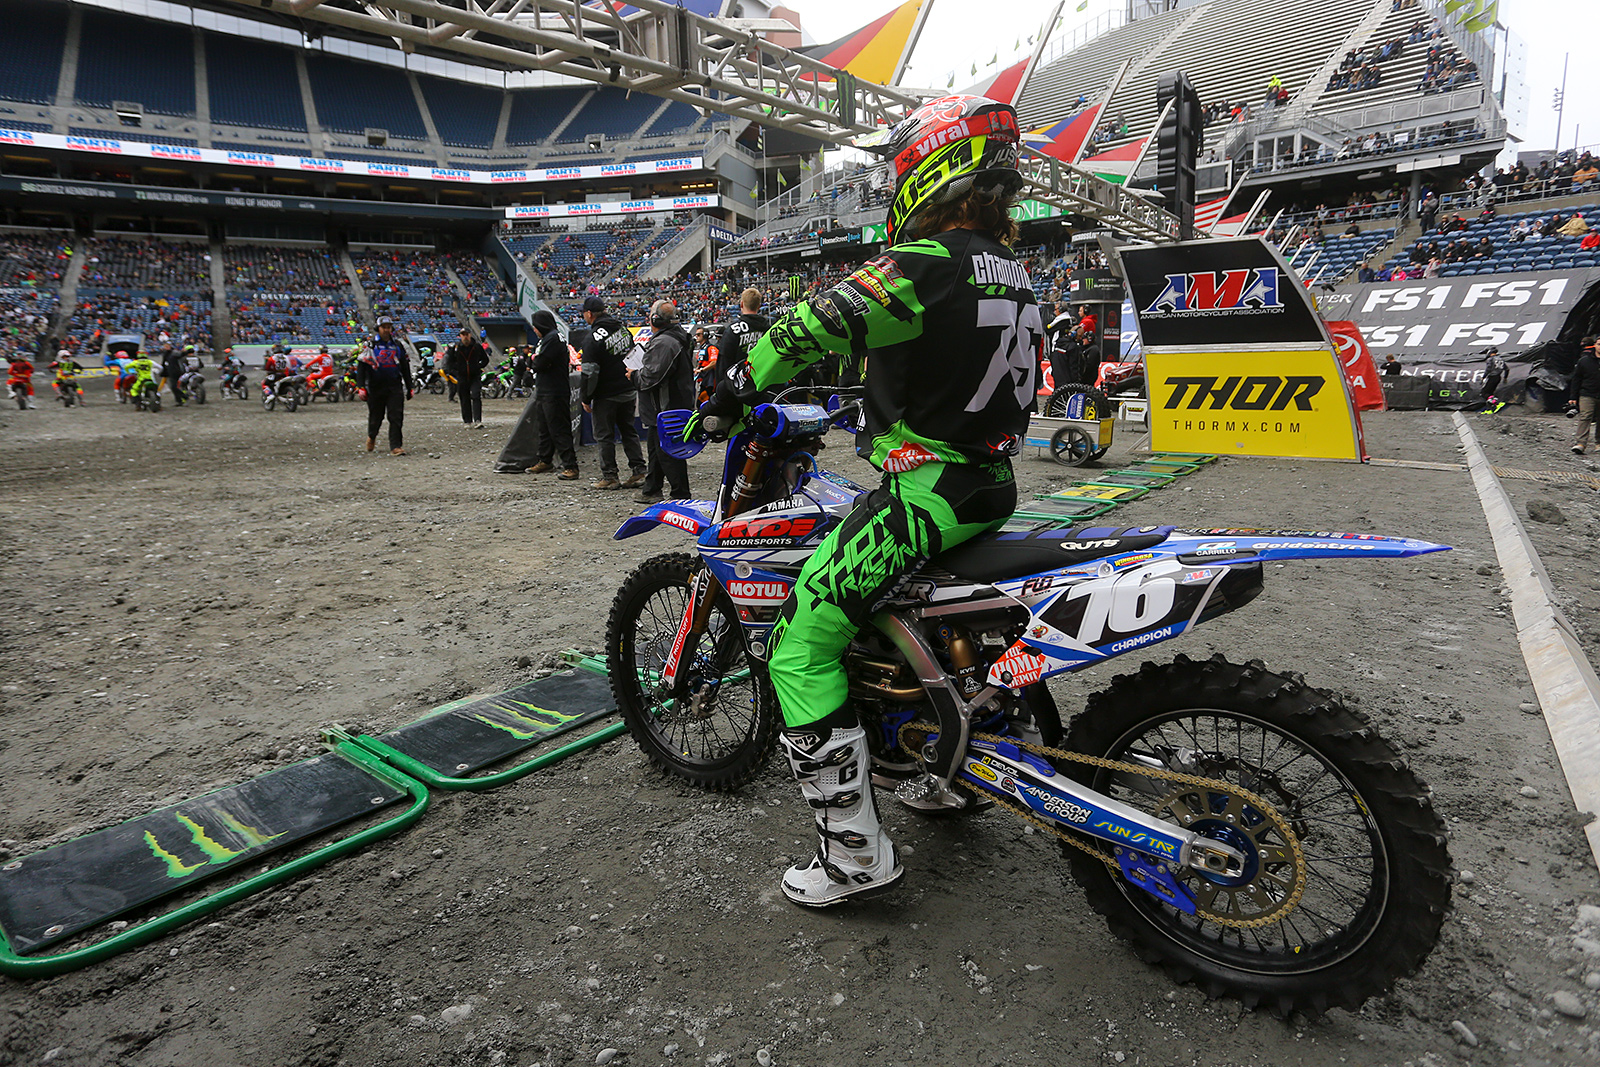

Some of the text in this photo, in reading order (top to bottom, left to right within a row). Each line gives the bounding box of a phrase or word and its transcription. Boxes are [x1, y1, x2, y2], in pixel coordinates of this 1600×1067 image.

[0, 129, 34, 140] RTS
[916, 120, 971, 157] viral
[66, 136, 121, 149] PARTS
[66, 144, 122, 154] UNLIMITED
[151, 144, 202, 156] PARTS
[151, 151, 202, 161] UNLIMITED
[227, 151, 275, 162] PARTS
[300, 157, 344, 167] PARTS
[228, 158, 276, 167] UNLIMITED
[300, 164, 345, 172] UNLIMITED
[367, 163, 409, 172] PARTS
[601, 163, 636, 171] PARTS
[656, 158, 692, 167] PARTS
[368, 169, 409, 177] UNLIMITED
[431, 168, 471, 177] PARTS
[546, 167, 581, 175] PARTS
[225, 197, 282, 208] RING OF HONOR
[620, 200, 654, 208] PARTS
[673, 196, 708, 205] PARTS
[568, 203, 602, 211] PARTS
[717, 229, 734, 242] DELTA
[1140, 266, 1285, 314] AMA
[1460, 278, 1569, 308] FS1
[1361, 285, 1453, 313] FS1
[1140, 308, 1285, 320] AMERICAN MOTORCYCLIST ASSOCIATION
[731, 321, 750, 334] 50
[592, 327, 609, 341] 48
[1438, 321, 1547, 347] FS1
[1163, 375, 1326, 411] THOR
[1173, 420, 1301, 433] THORMX.COM
[766, 498, 804, 511] YAMAHA
[663, 512, 695, 532] MOTUL
[718, 518, 817, 539] RIDE
[721, 538, 792, 546] MOTORSPORTS
[1060, 539, 1120, 550] GUTS
[1196, 548, 1237, 556] CARRILLO
[1181, 569, 1213, 583] AMA
[730, 582, 786, 597] MOTUL
[1065, 561, 1177, 645] 76
[1111, 626, 1173, 653] CHAMPION
[1005, 645, 1021, 659] THE
[991, 759, 1019, 777] DEVOL
[1025, 786, 1092, 818] ANDERSON
[1043, 802, 1087, 824] GROUP
